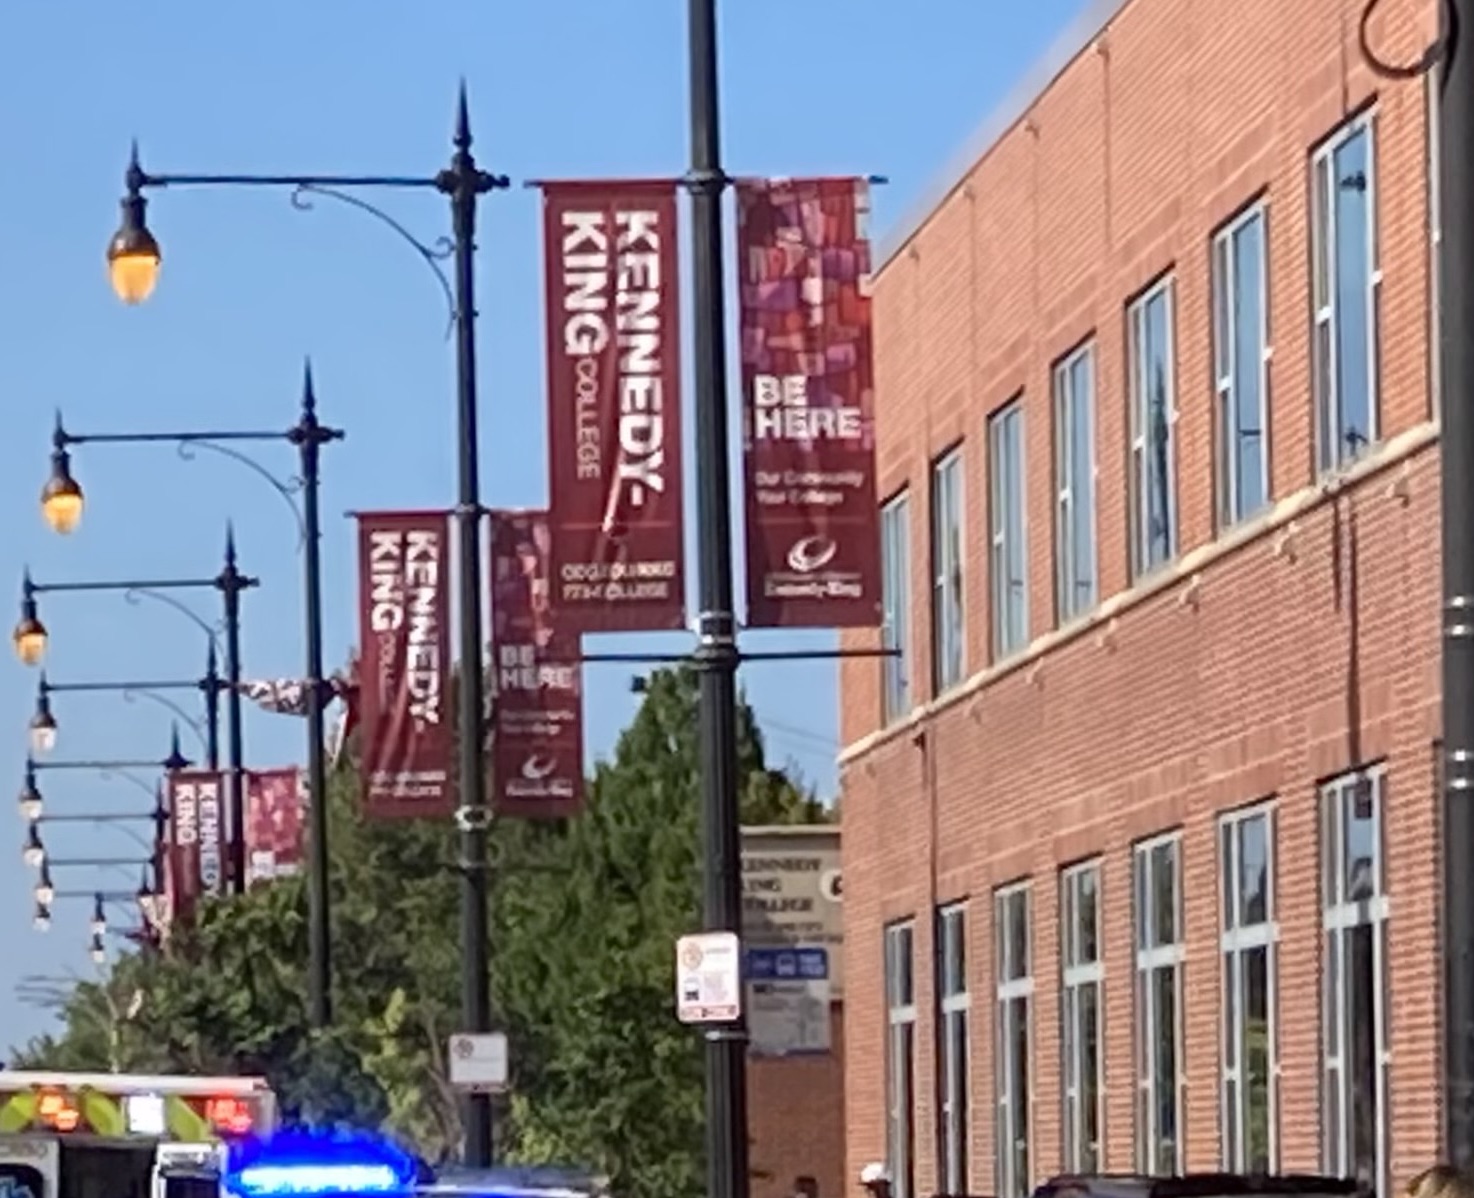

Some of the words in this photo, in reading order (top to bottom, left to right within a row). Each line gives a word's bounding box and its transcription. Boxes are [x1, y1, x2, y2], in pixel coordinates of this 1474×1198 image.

[562, 210, 609, 356] KING
[754, 374, 807, 406] BE
[576, 360, 601, 479] COLLEGE
[754, 407, 861, 439] HERE
[371, 531, 404, 632] KING
[500, 645, 535, 667] BE
[500, 666, 574, 689] HERE
[175, 784, 197, 846] KING
